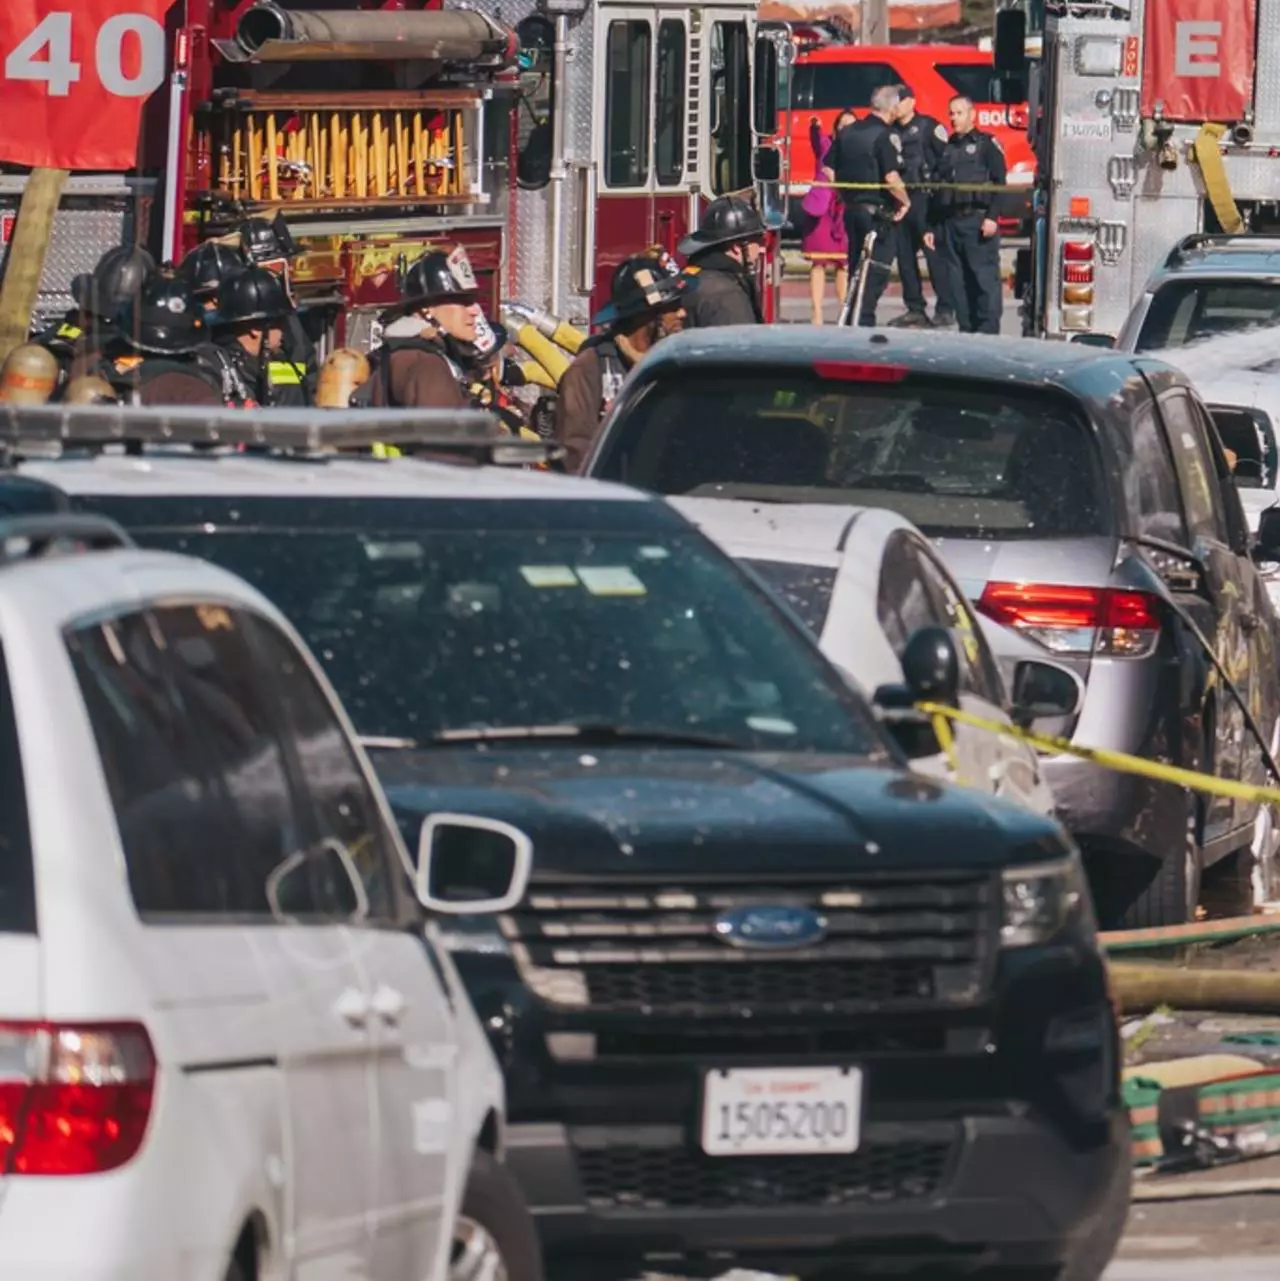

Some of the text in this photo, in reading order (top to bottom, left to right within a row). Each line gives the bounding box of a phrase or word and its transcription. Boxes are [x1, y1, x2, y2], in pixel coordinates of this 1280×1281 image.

[4, 11, 166, 97] 40
[1175, 21, 1222, 77] E
[718, 1101, 848, 1141] 1505200
